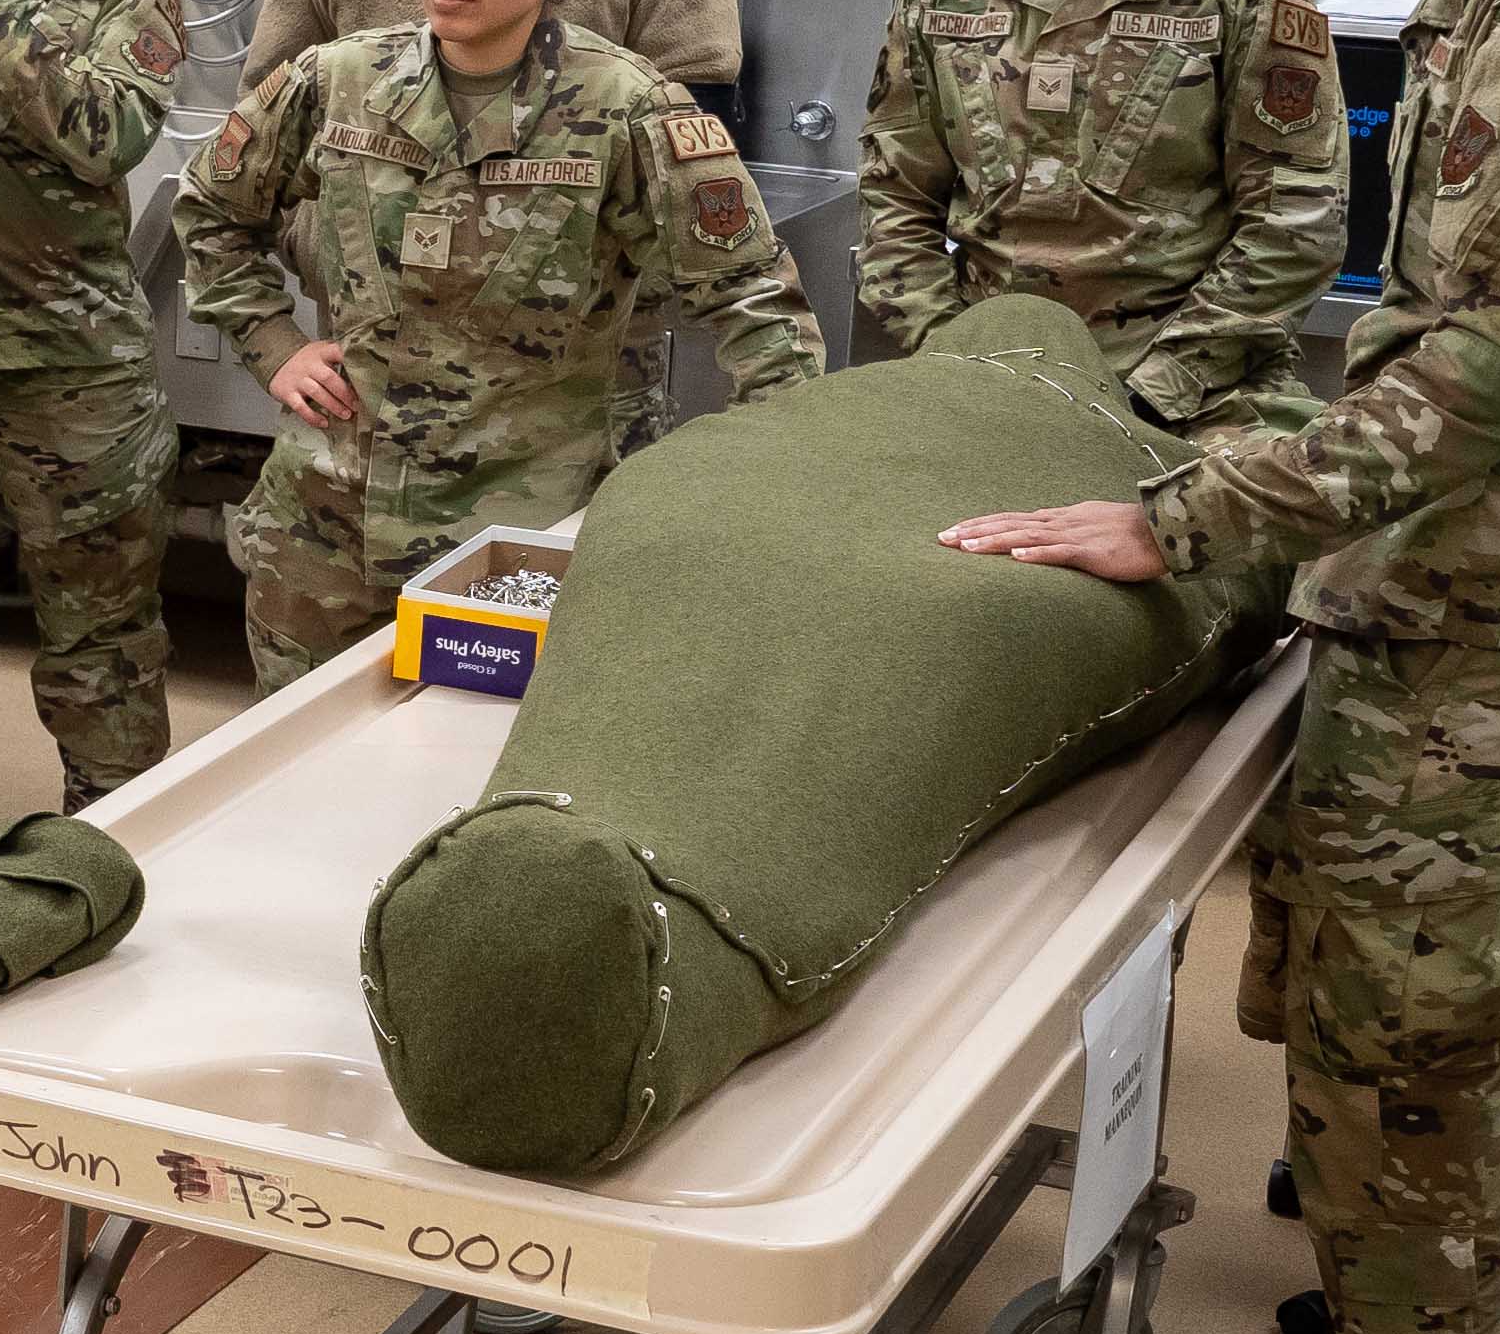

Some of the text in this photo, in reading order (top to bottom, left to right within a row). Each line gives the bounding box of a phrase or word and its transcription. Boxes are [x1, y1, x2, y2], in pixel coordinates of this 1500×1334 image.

[1118, 19, 1212, 38] U.S. AIR FORCE
[1282, 8, 1320, 47] SVS
[1348, 106, 1389, 126] odge
[327, 126, 431, 167] ANDUJAR CRUZ
[676, 119, 728, 152] SVS
[486, 162, 596, 184] U.S. AIR FORCE
[436, 636, 521, 665] Safety Pins
[458, 662, 484, 674] Closed
